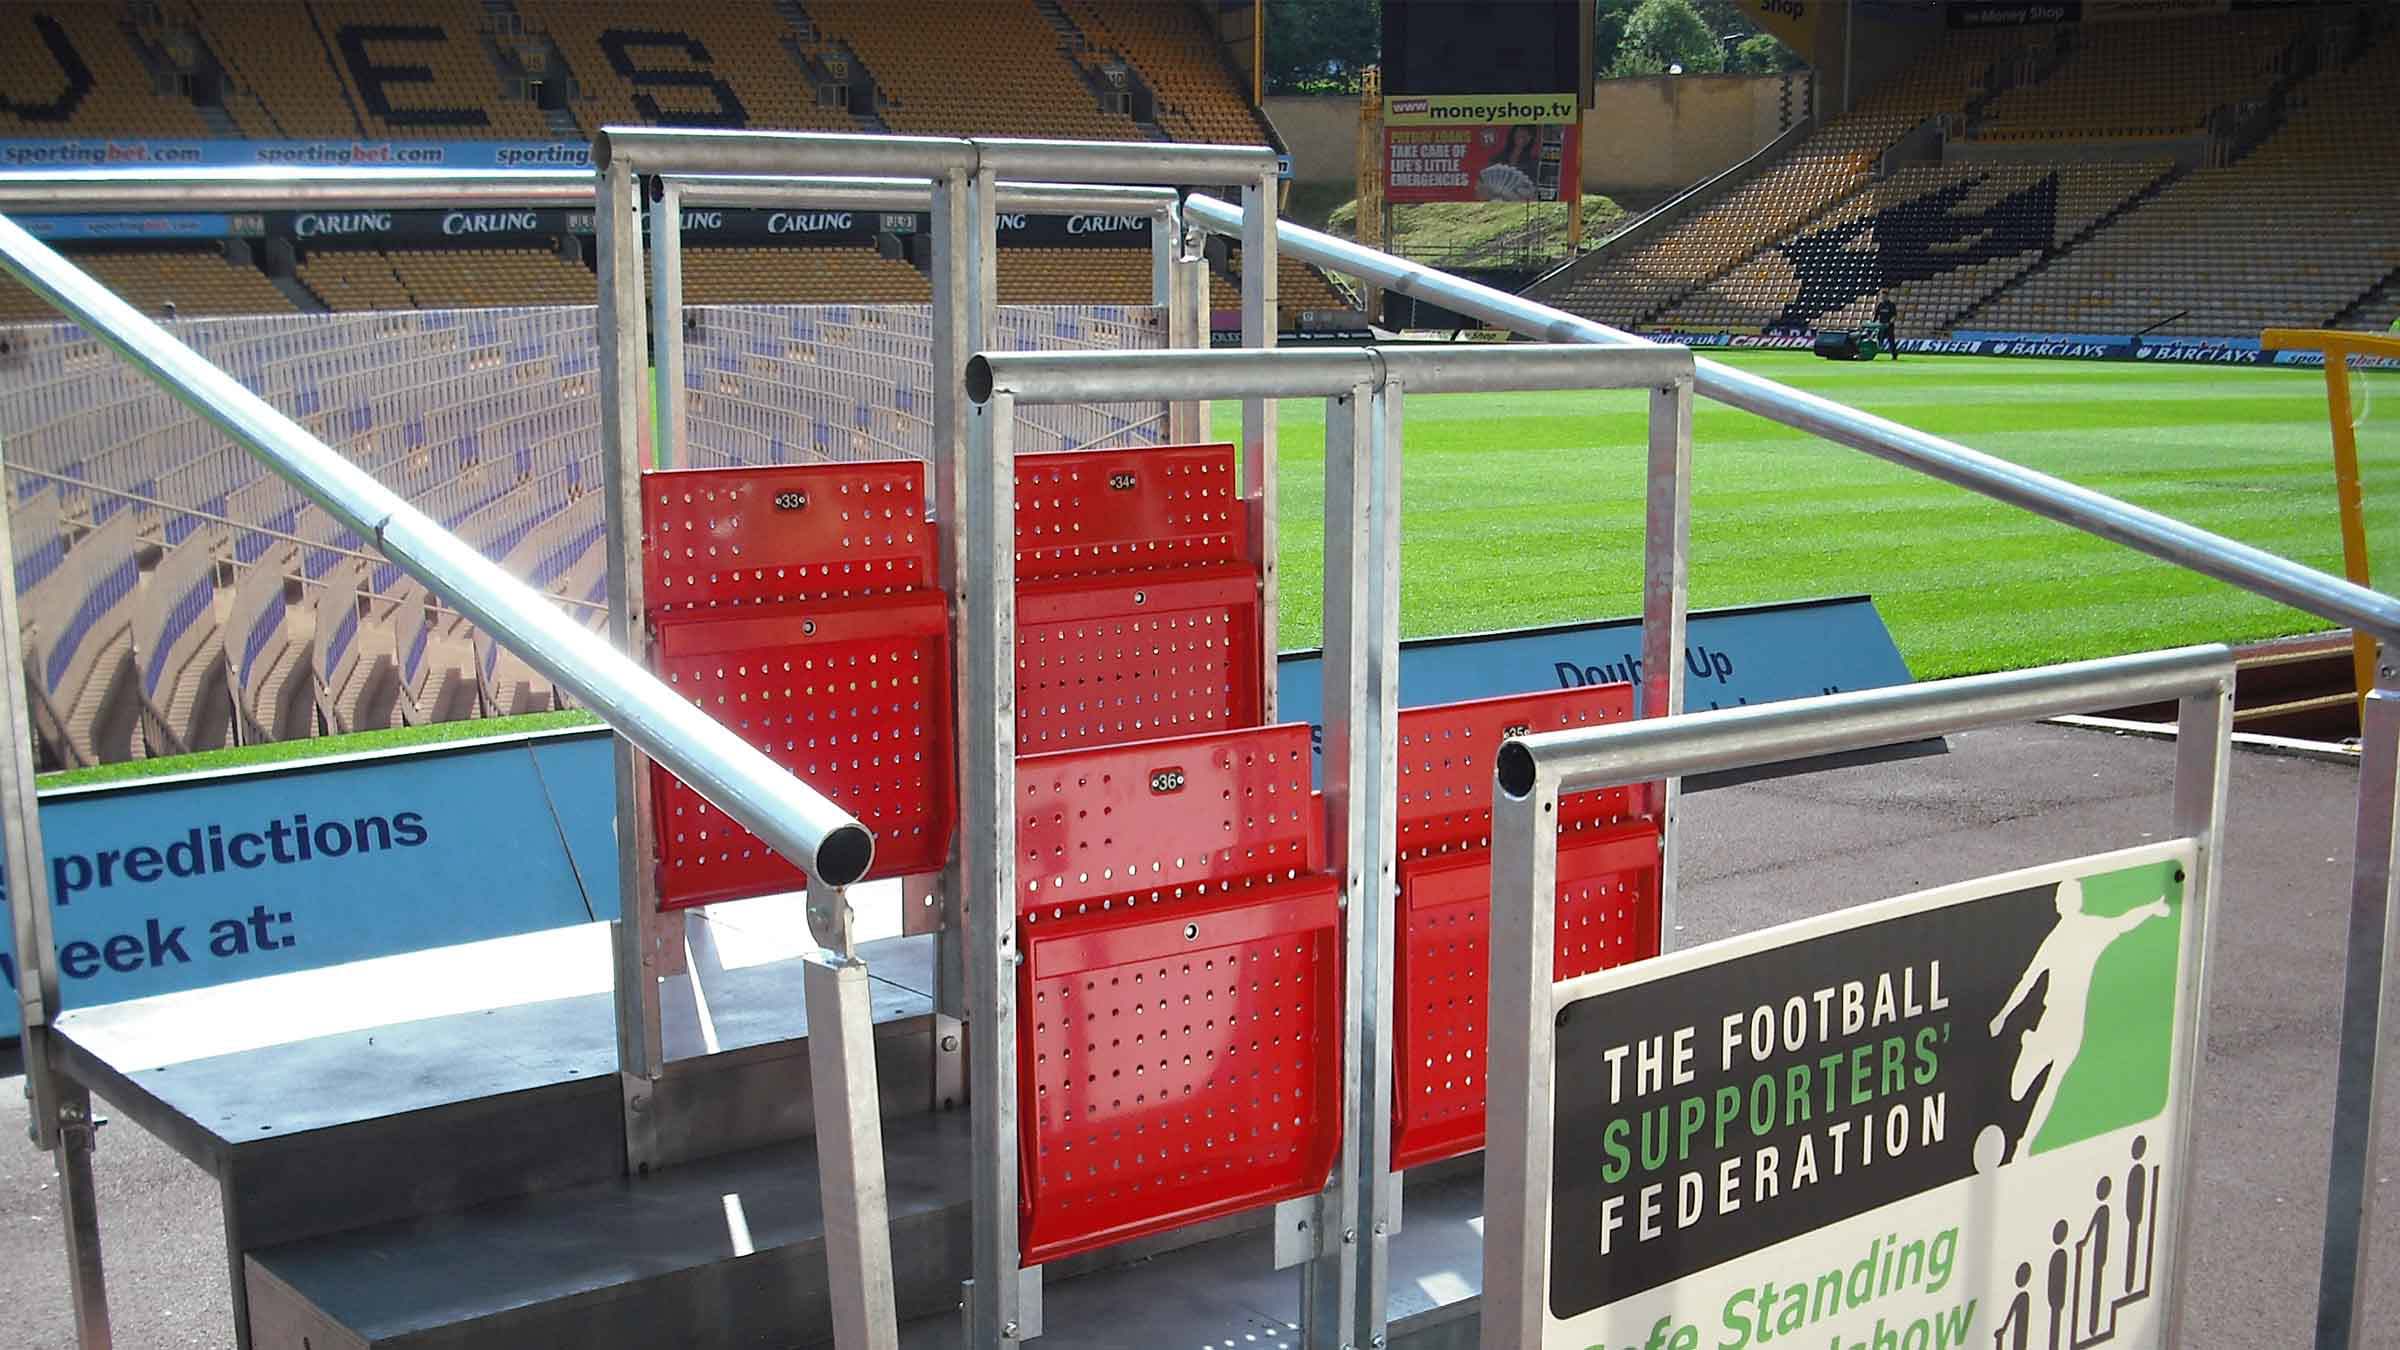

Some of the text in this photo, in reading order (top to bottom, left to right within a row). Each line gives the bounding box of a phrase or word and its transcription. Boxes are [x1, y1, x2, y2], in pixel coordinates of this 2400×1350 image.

[1430, 102, 1571, 122] moneyshop.tv
[5, 142, 202, 164] sportingbet.com
[256, 143, 444, 165] sportingbet.com
[495, 143, 592, 166] sporting
[1390, 144, 1467, 158] TAKE CARE OF
[1425, 159, 1461, 172] LITTLE
[1391, 173, 1470, 186] EMERGENCIES
[294, 212, 392, 238] CARLING
[442, 211, 537, 236] CARLING
[767, 212, 852, 233] CARLING
[1066, 214, 1144, 235] CARLING
[2010, 342, 2107, 358] BARCLAYS
[2155, 347, 2259, 362] BARCLAYS
[1115, 475, 1130, 489] 34
[782, 494, 799, 508] 33
[1685, 646, 1733, 685] Up
[1158, 772, 1177, 790] 36
[51, 810, 429, 906] predictions
[208, 904, 296, 958] at:
[1603, 960, 1949, 1105] THE FOOTBALL
[1600, 1091, 1946, 1256] FEDERATION
[1717, 1226, 1960, 1350] Standing
